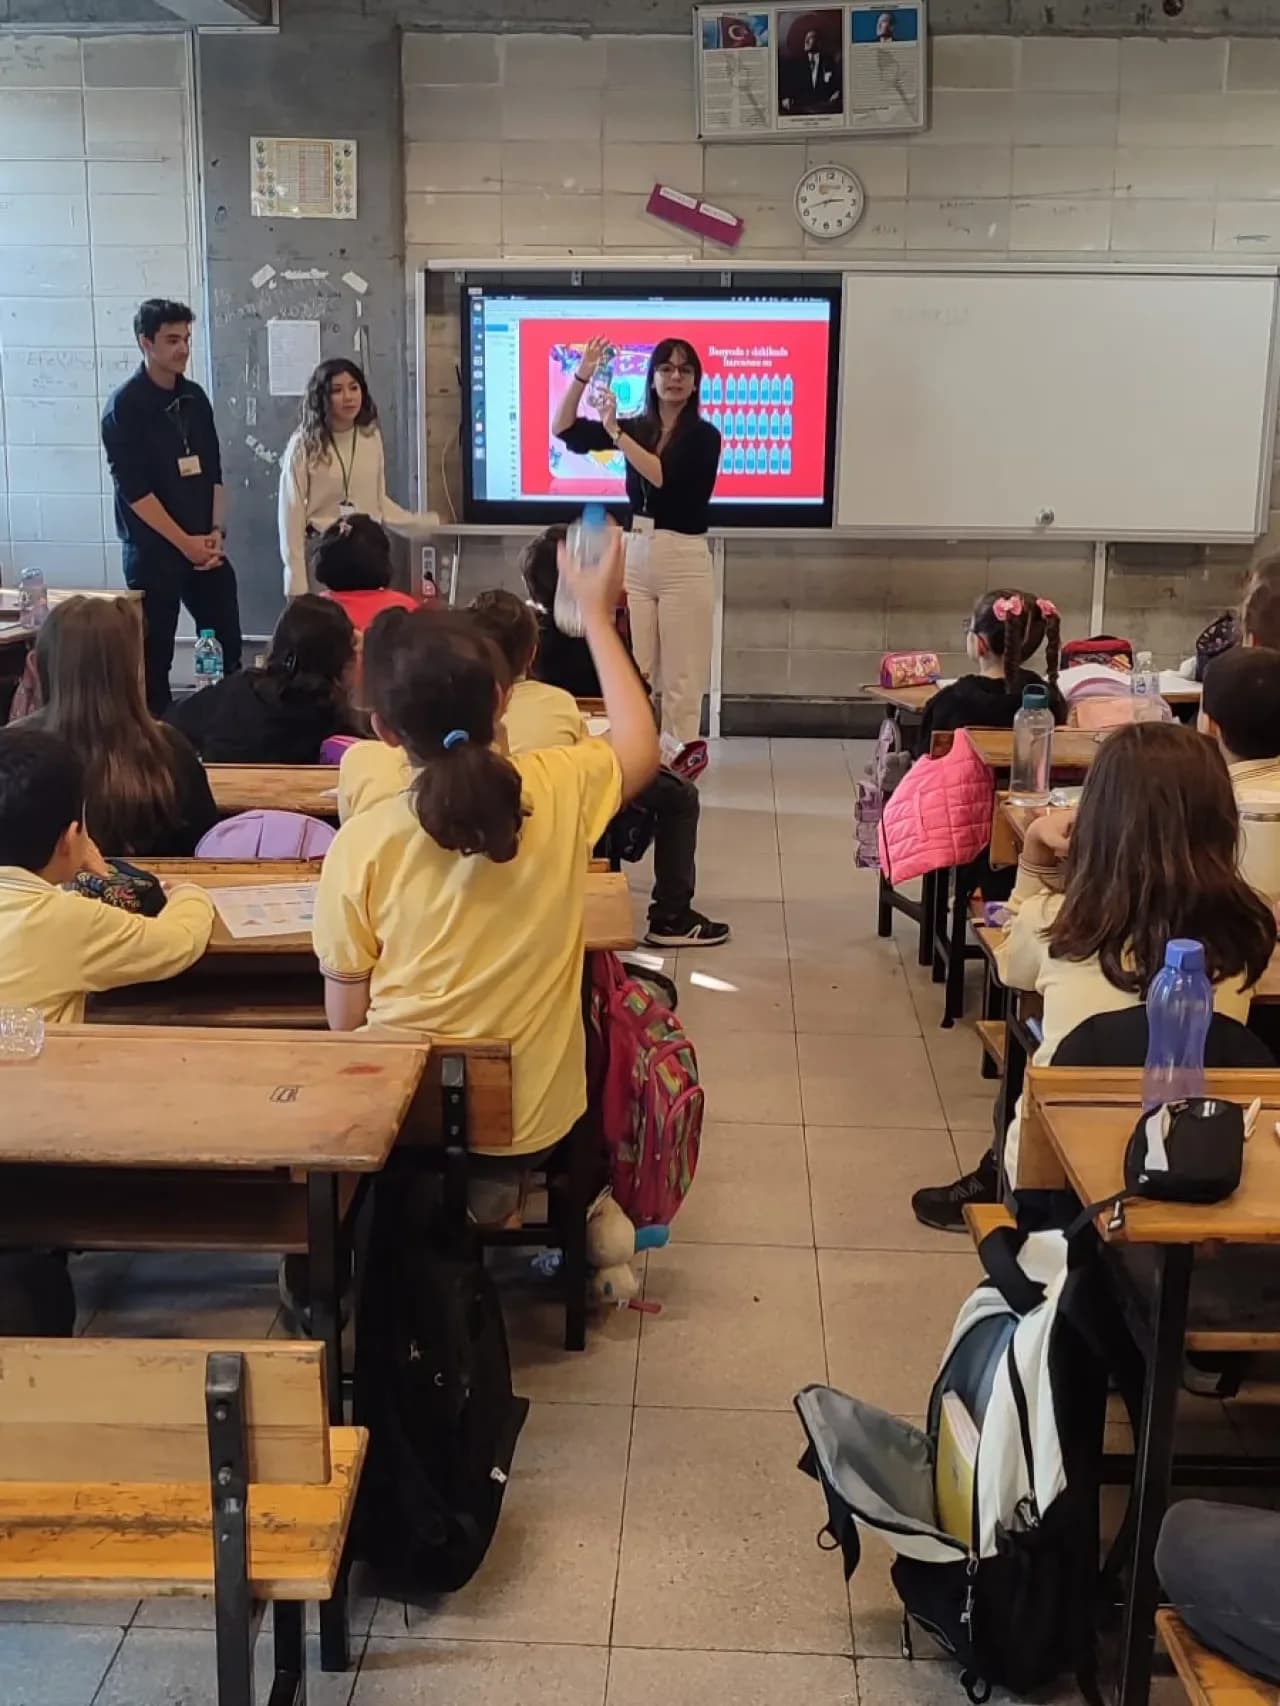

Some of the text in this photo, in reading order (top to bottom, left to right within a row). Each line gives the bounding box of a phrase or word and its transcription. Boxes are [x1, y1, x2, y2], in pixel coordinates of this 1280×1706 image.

[806, 182, 816, 191] 10
[847, 185, 854, 193] 2
[850, 198, 856, 206] 3
[811, 217, 817, 226] 7
[823, 221, 830, 230] 6
[836, 218, 843, 227] 5
